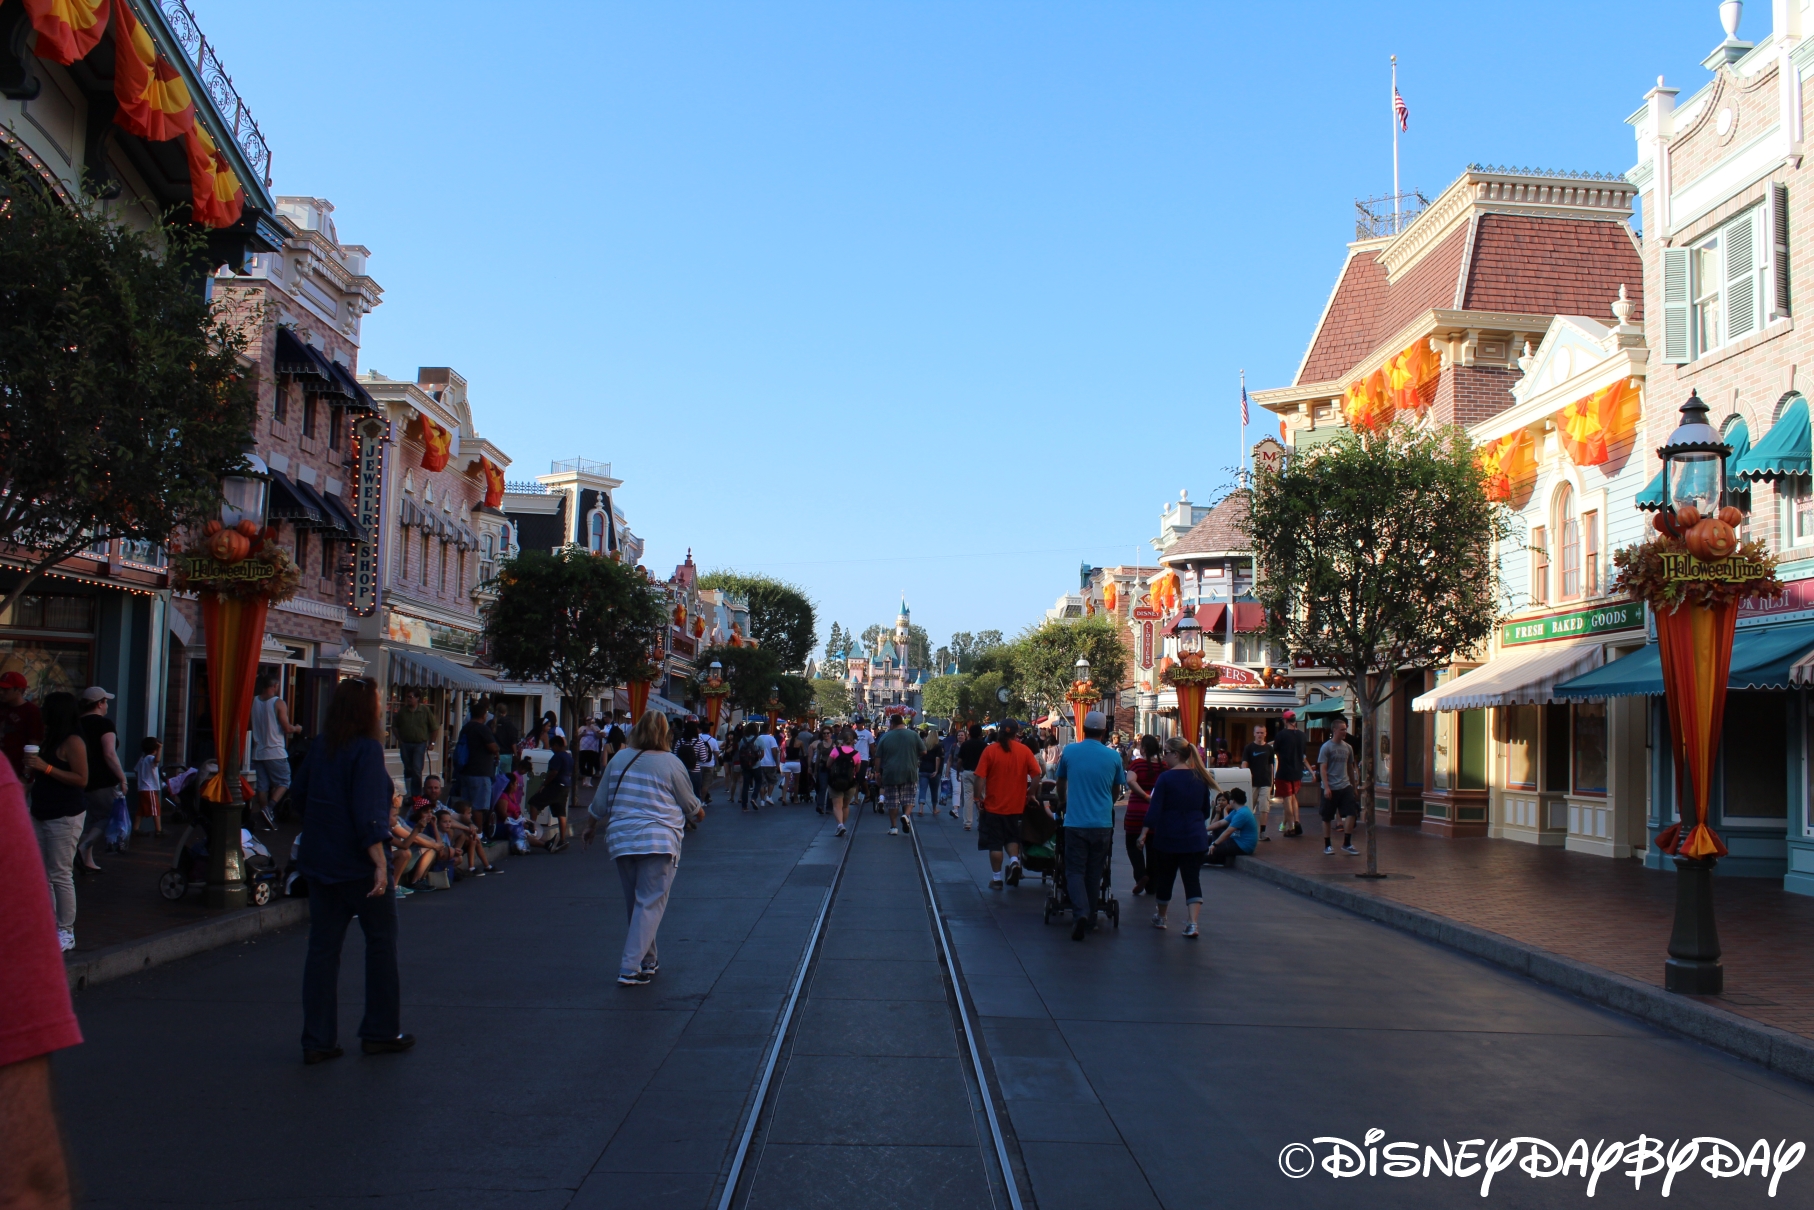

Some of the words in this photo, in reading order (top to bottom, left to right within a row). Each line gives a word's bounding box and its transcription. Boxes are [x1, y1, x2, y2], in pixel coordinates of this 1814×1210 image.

[359, 546, 371, 598] SHOP
[1515, 623, 1544, 639] FRESH
[1551, 617, 1584, 634] BAKED
[1591, 609, 1627, 628] GOODS
